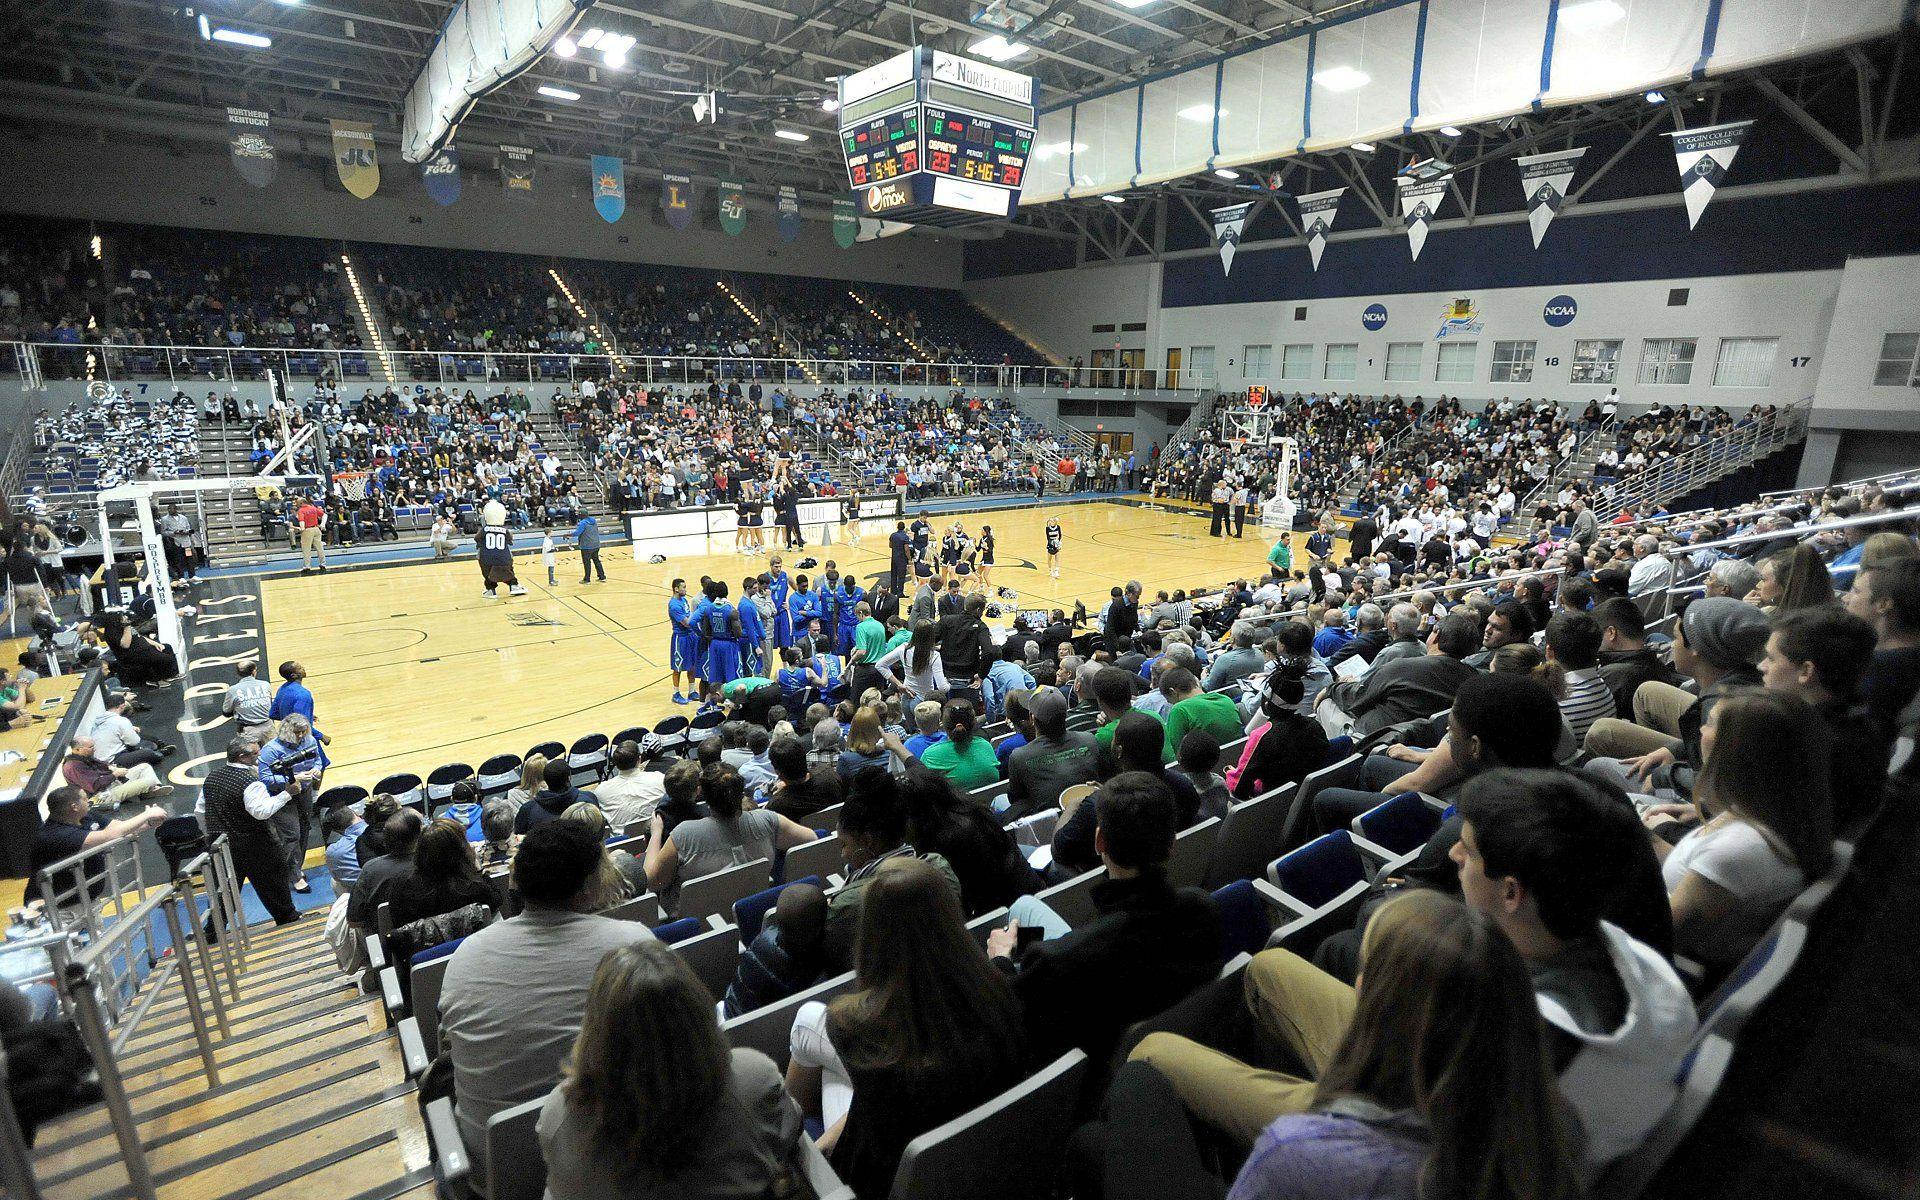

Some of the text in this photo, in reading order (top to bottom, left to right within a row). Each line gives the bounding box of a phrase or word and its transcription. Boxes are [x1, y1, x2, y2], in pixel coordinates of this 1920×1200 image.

[957, 62, 990, 88] NORTH
[226, 107, 269, 119] NORTHERN
[927, 109, 945, 119] FOULS
[229, 115, 269, 126] KENTUCKY
[871, 119, 885, 129] PLAYER
[972, 118, 991, 129] PLAYER
[334, 130, 373, 140] JACKSONVILLE
[1015, 129, 1032, 139] FOULS
[1677, 128, 1743, 144] COGGIN COLLEGE
[928, 140, 958, 154] OSPREYS
[1021, 140, 1029, 154] 4
[1698, 138, 1732, 148] BUSINESS
[500, 144, 534, 155] KENNESAW
[966, 149, 983, 158] PERIOD
[341, 148, 375, 167] JU
[508, 153, 527, 161] STATE
[932, 151, 951, 173] 23
[998, 154, 1024, 168] VISITOR
[425, 163, 457, 175] FGCU
[875, 158, 898, 180] 5:46
[964, 160, 995, 181] 5:46
[663, 174, 690, 183] LIPSCOMB
[669, 185, 687, 209] L
[882, 191, 906, 208] max
[1545, 306, 1576, 317] NCAA
[1363, 313, 1387, 322] NCAA
[1228, 358, 1235, 366] 2
[1367, 358, 1373, 367] 1
[1544, 357, 1560, 367] 18
[1790, 356, 1812, 368] 17
[137, 383, 149, 394] 7
[415, 384, 425, 395] 6
[485, 532, 506, 550] 00
